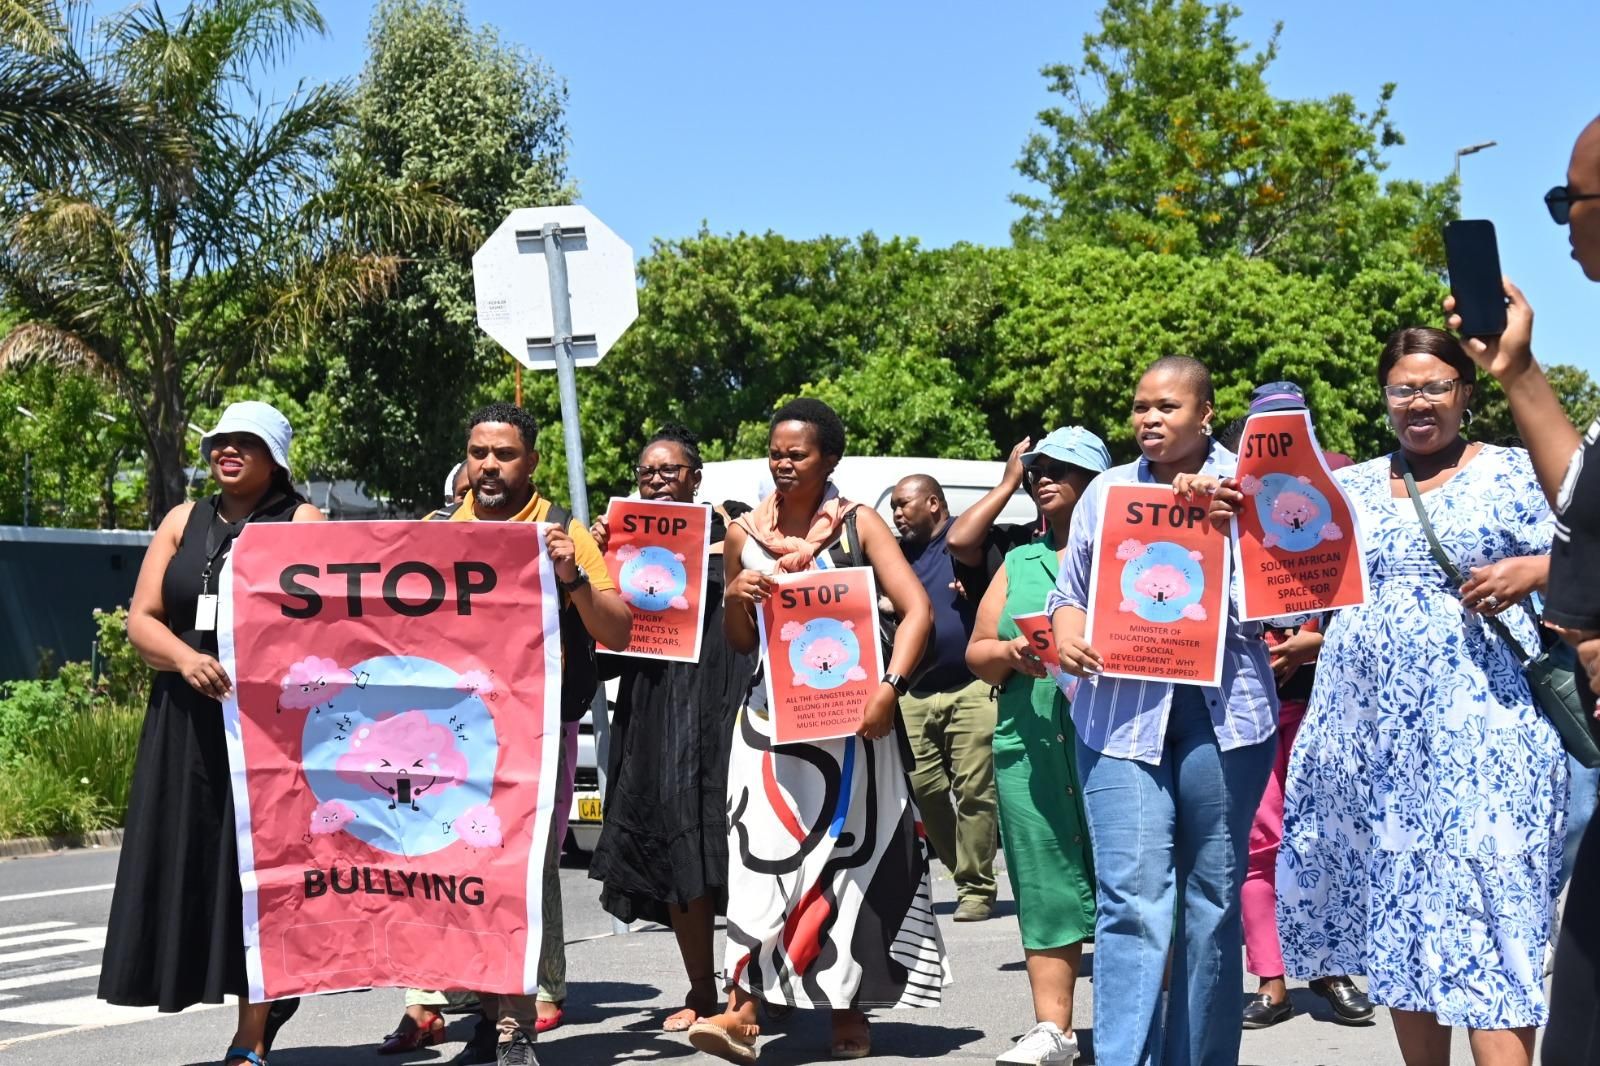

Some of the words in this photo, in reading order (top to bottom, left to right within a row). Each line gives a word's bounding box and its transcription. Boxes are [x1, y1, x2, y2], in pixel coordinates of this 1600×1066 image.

[1260, 559, 1295, 572] SOUTH
[1298, 552, 1341, 567] AFRICAN
[1267, 572, 1297, 586] RIGBY
[1300, 569, 1319, 581] HAS
[1322, 567, 1338, 577] NO
[278, 561, 497, 618] STOP
[1278, 586, 1308, 599] SPACE
[1311, 583, 1330, 594] FOR
[633, 613, 663, 622] RUGBY
[631, 623, 666, 634] TRACTS
[667, 627, 679, 635] VS
[1129, 625, 1168, 634] MINISTER
[1170, 628, 1182, 636] OF
[1032, 628, 1053, 650] S
[1160, 638, 1200, 648] MINISTER
[1145, 646, 1175, 655] SOCIAL
[1105, 662, 1121, 671] ARE
[1123, 664, 1146, 672] YOUR
[1166, 667, 1199, 677] ZIPPED?
[1175, 659, 1196, 667] WHY
[814, 690, 855, 701] GANGSTERS
[793, 703, 821, 712] BELONG
[846, 698, 862, 706] AND
[796, 721, 819, 729] MUSIC
[303, 866, 485, 906] BULLYING
